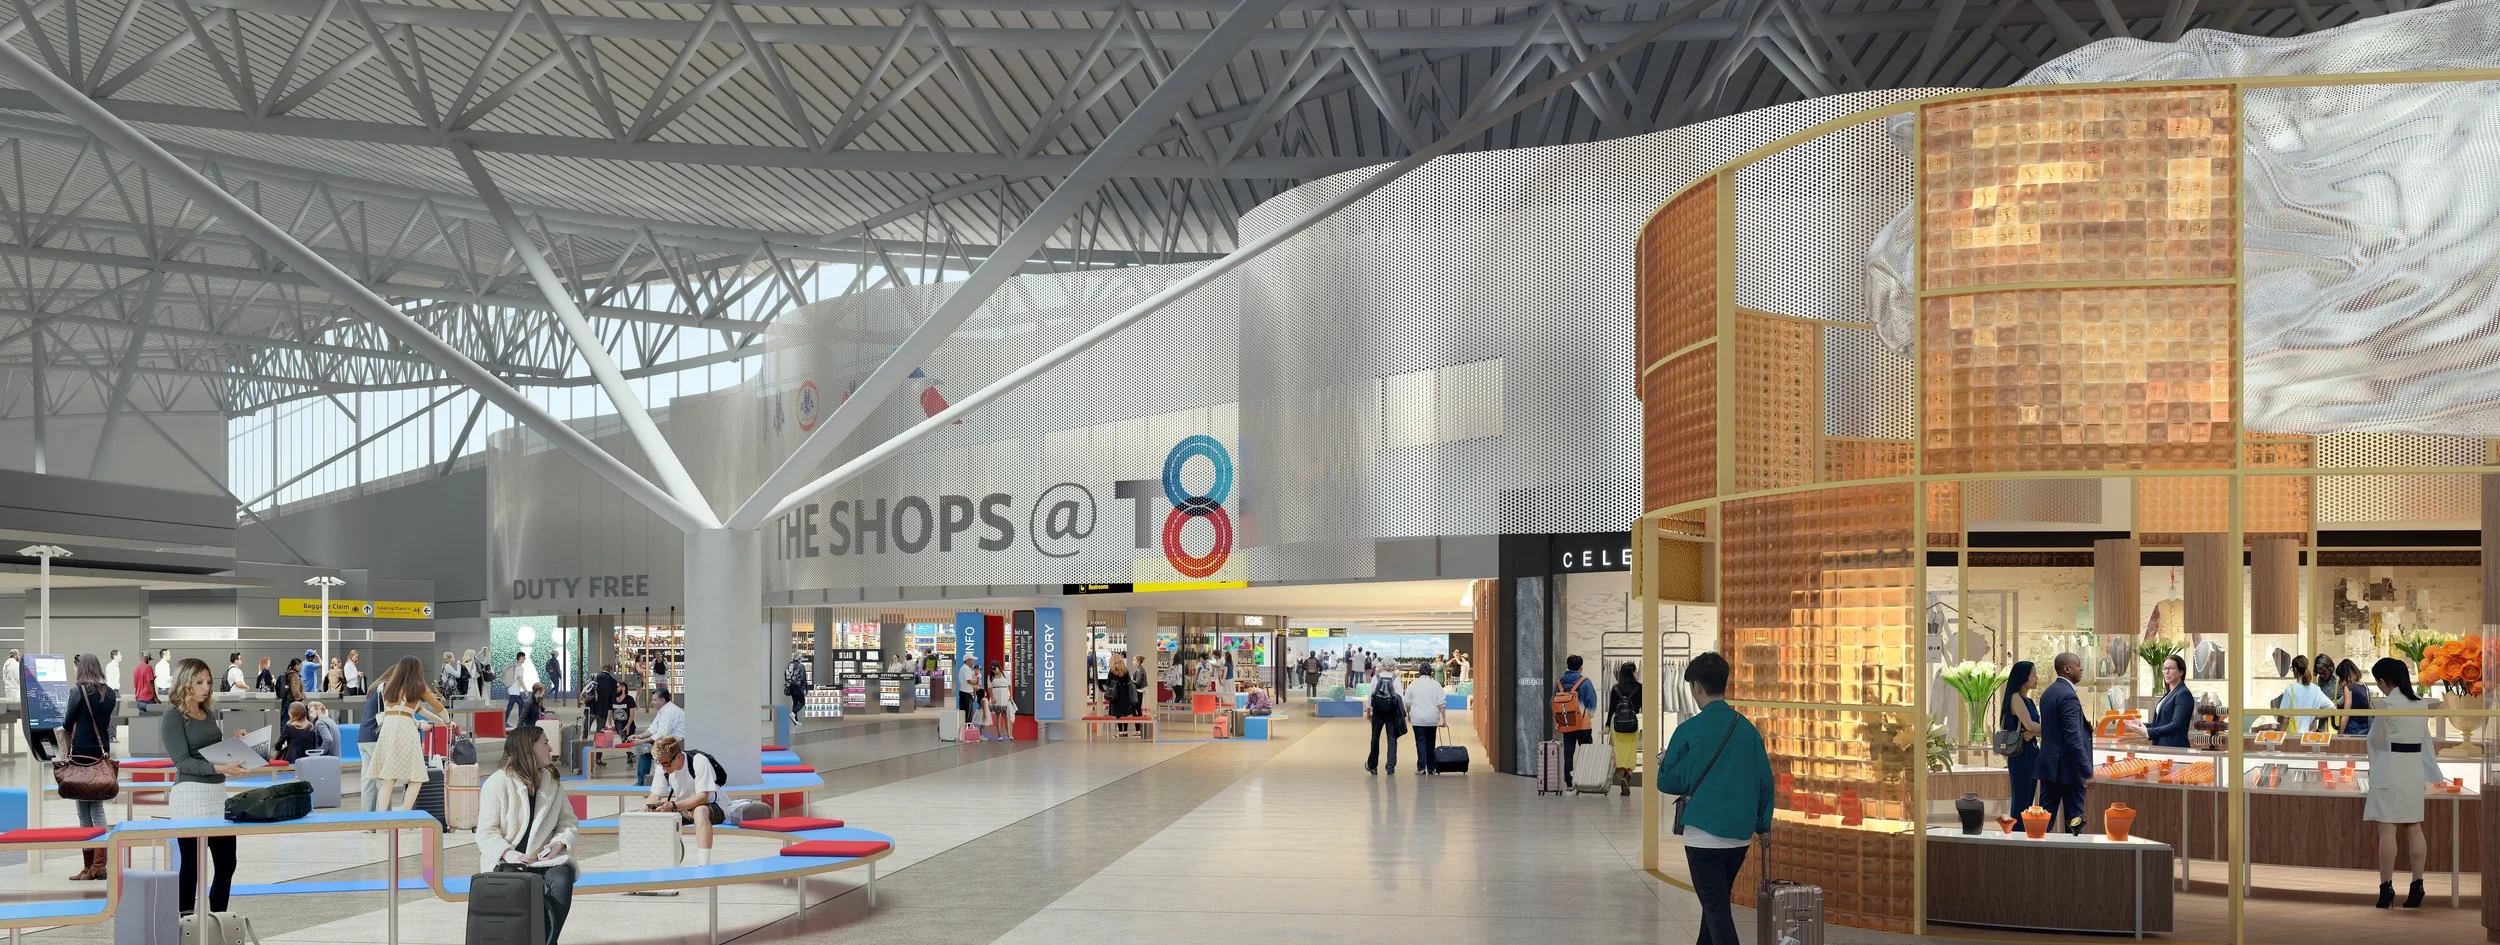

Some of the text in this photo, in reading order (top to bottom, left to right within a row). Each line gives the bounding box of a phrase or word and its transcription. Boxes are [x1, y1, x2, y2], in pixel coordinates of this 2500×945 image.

[775, 503, 819, 561] THE
[829, 492, 1016, 557] SHOPS
[1029, 481, 1097, 558] @
[513, 574, 649, 600] DUTY FREE
[964, 626, 975, 654] INFO
[1044, 624, 1055, 701] DIRECTORY
